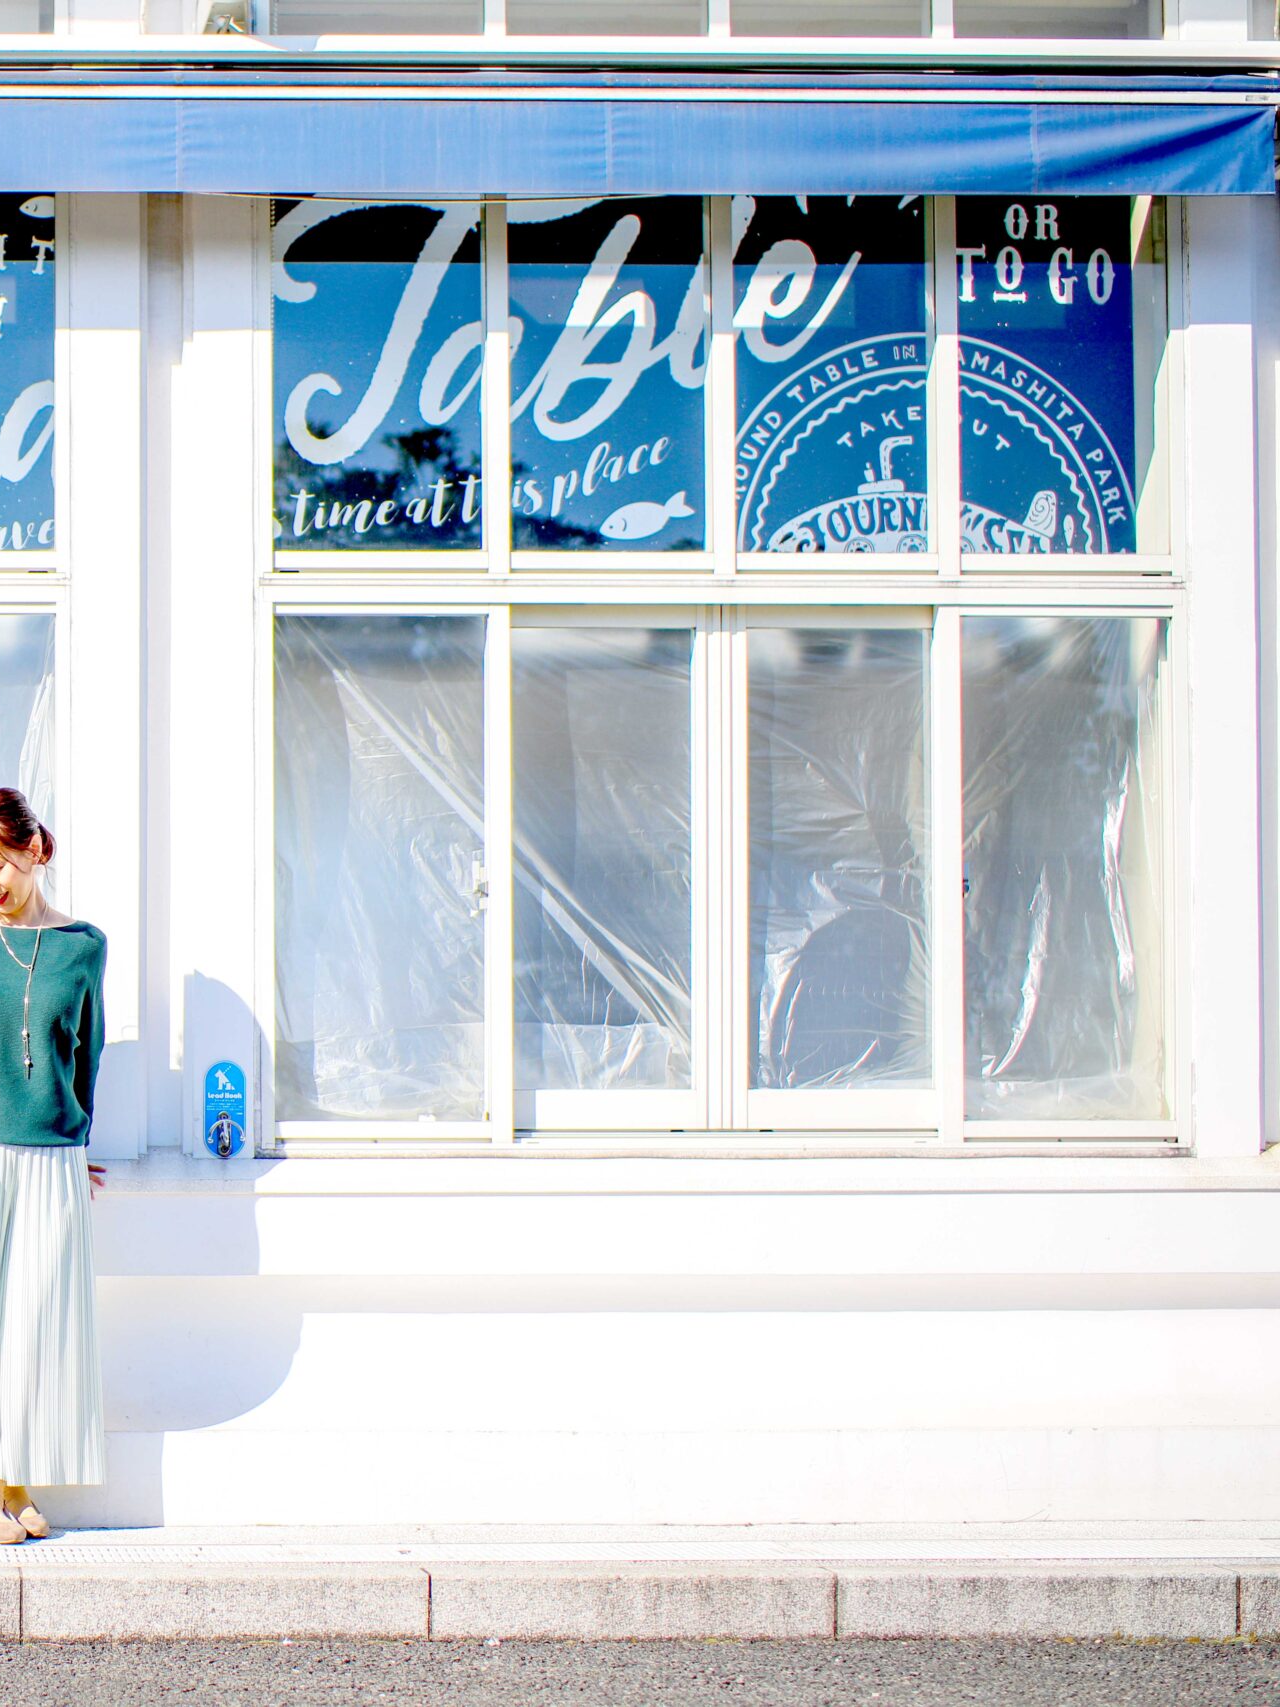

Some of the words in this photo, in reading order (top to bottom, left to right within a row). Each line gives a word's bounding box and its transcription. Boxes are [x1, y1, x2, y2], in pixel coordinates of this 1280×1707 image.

[1004, 203, 1061, 241] OR
[957, 246, 1027, 304] TO
[1046, 246, 1116, 305] GO
[786, 348, 877, 404] TABLE
[892, 344, 917, 361] IN
[1085, 448, 1127, 525] PARK
[836, 406, 922, 448] TAKE
[972, 418, 1010, 452] UT
[290, 489, 399, 537] time
[403, 477, 456, 528] at
[459, 475, 544, 515] tis
[549, 435, 671, 518] place
